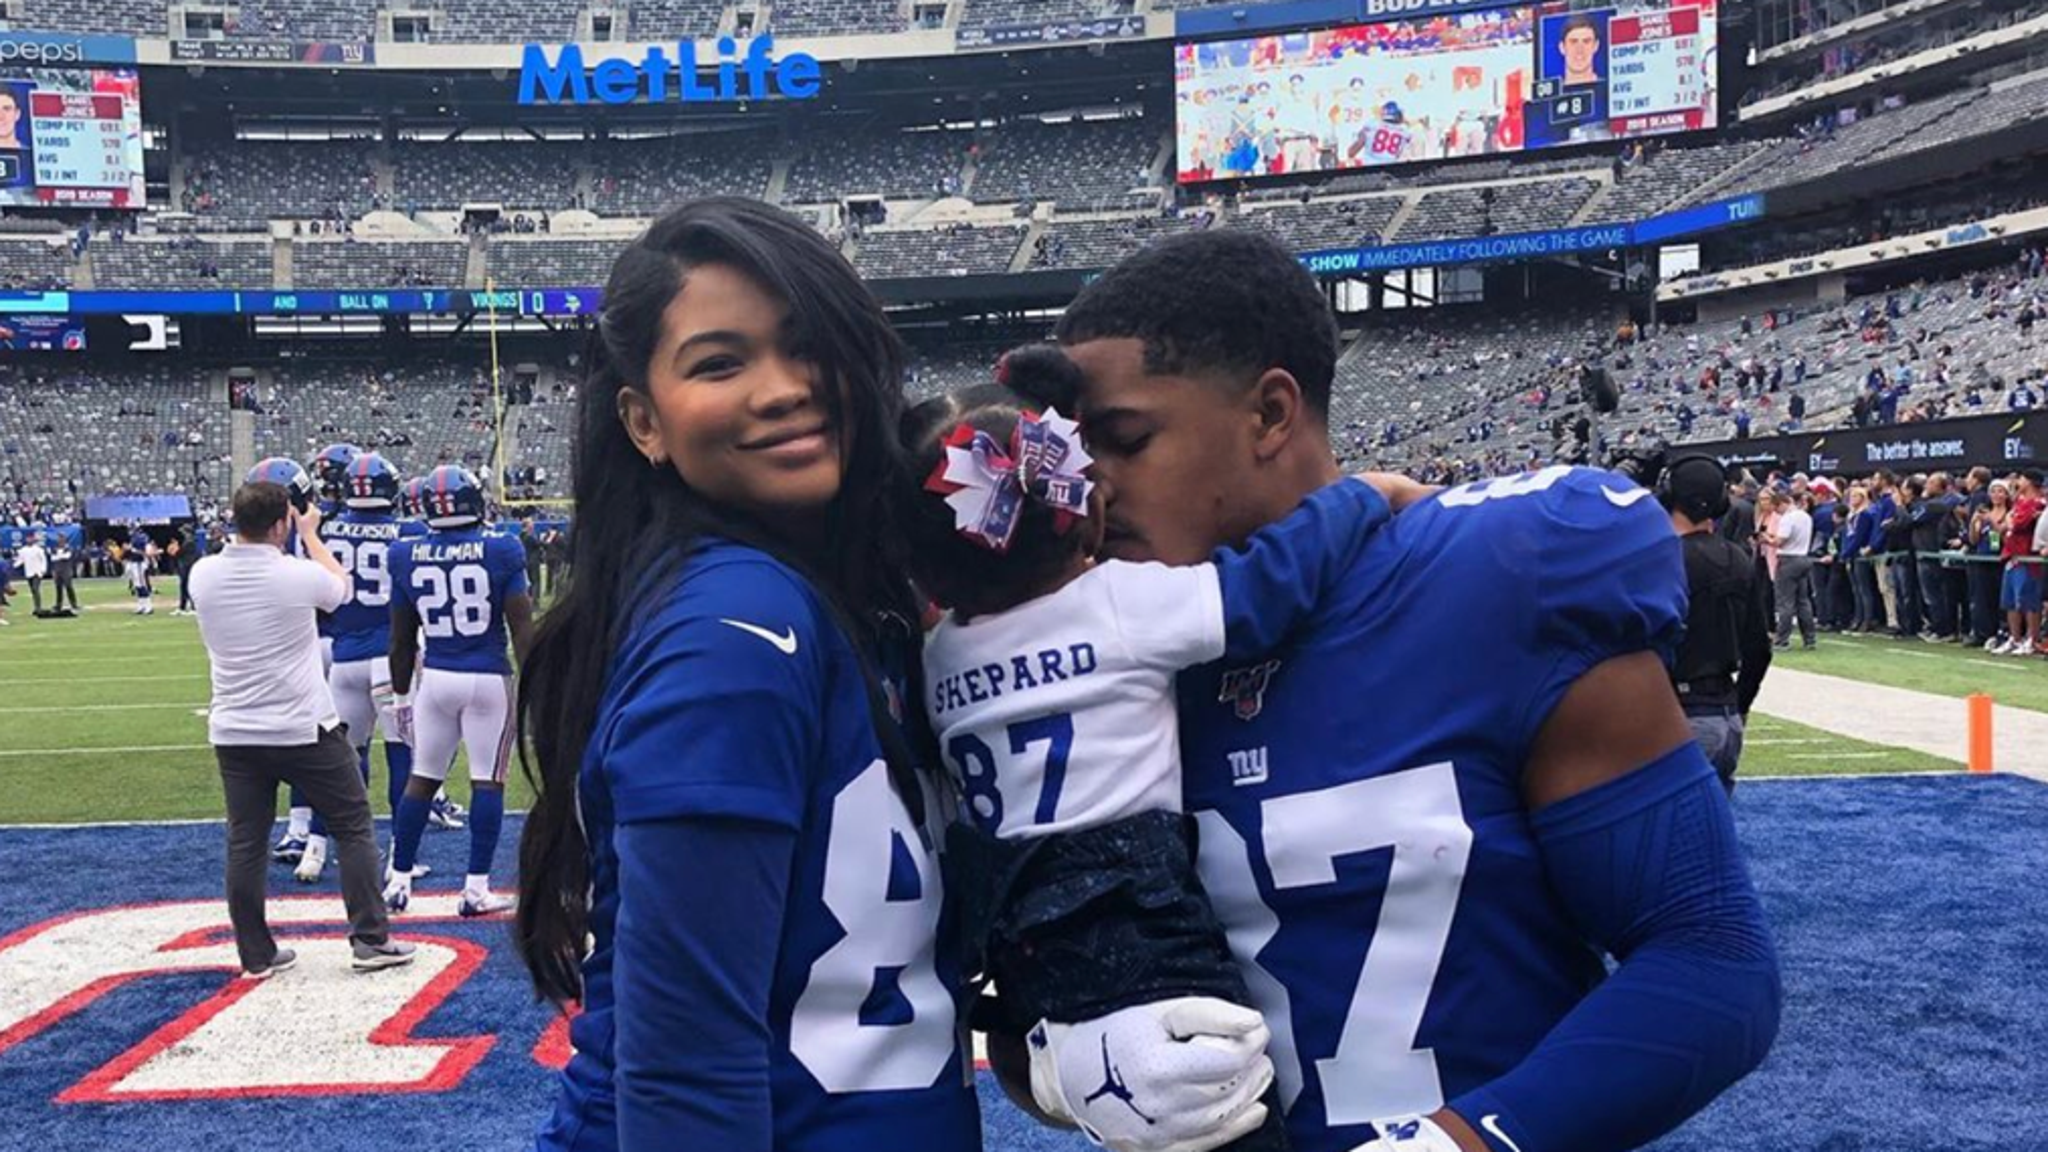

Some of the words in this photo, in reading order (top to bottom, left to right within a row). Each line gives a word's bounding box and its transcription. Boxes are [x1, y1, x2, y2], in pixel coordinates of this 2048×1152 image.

[0, 40, 83, 65] pepsi
[518, 30, 820, 104] MetLife
[1612, 62, 1645, 74] YARDS
[1372, 129, 1401, 154] 88
[1309, 253, 1360, 271] SHOW
[1362, 244, 1457, 267] IMMEDIATELY
[1459, 235, 1546, 259] FOLLOWING
[1551, 233, 1578, 250] THE
[1580, 227, 1626, 248] GAME
[273, 294, 297, 309] AND
[339, 294, 369, 309] BALL
[372, 294, 389, 309] ON
[2004, 437, 2021, 460] EY
[320, 520, 401, 539] DICKERSON
[411, 541, 484, 562] HILLIMAN
[411, 564, 492, 638] 28
[935, 642, 1097, 714] SHEPARD
[948, 712, 1074, 837] 87
[1227, 746, 1269, 786] ny
